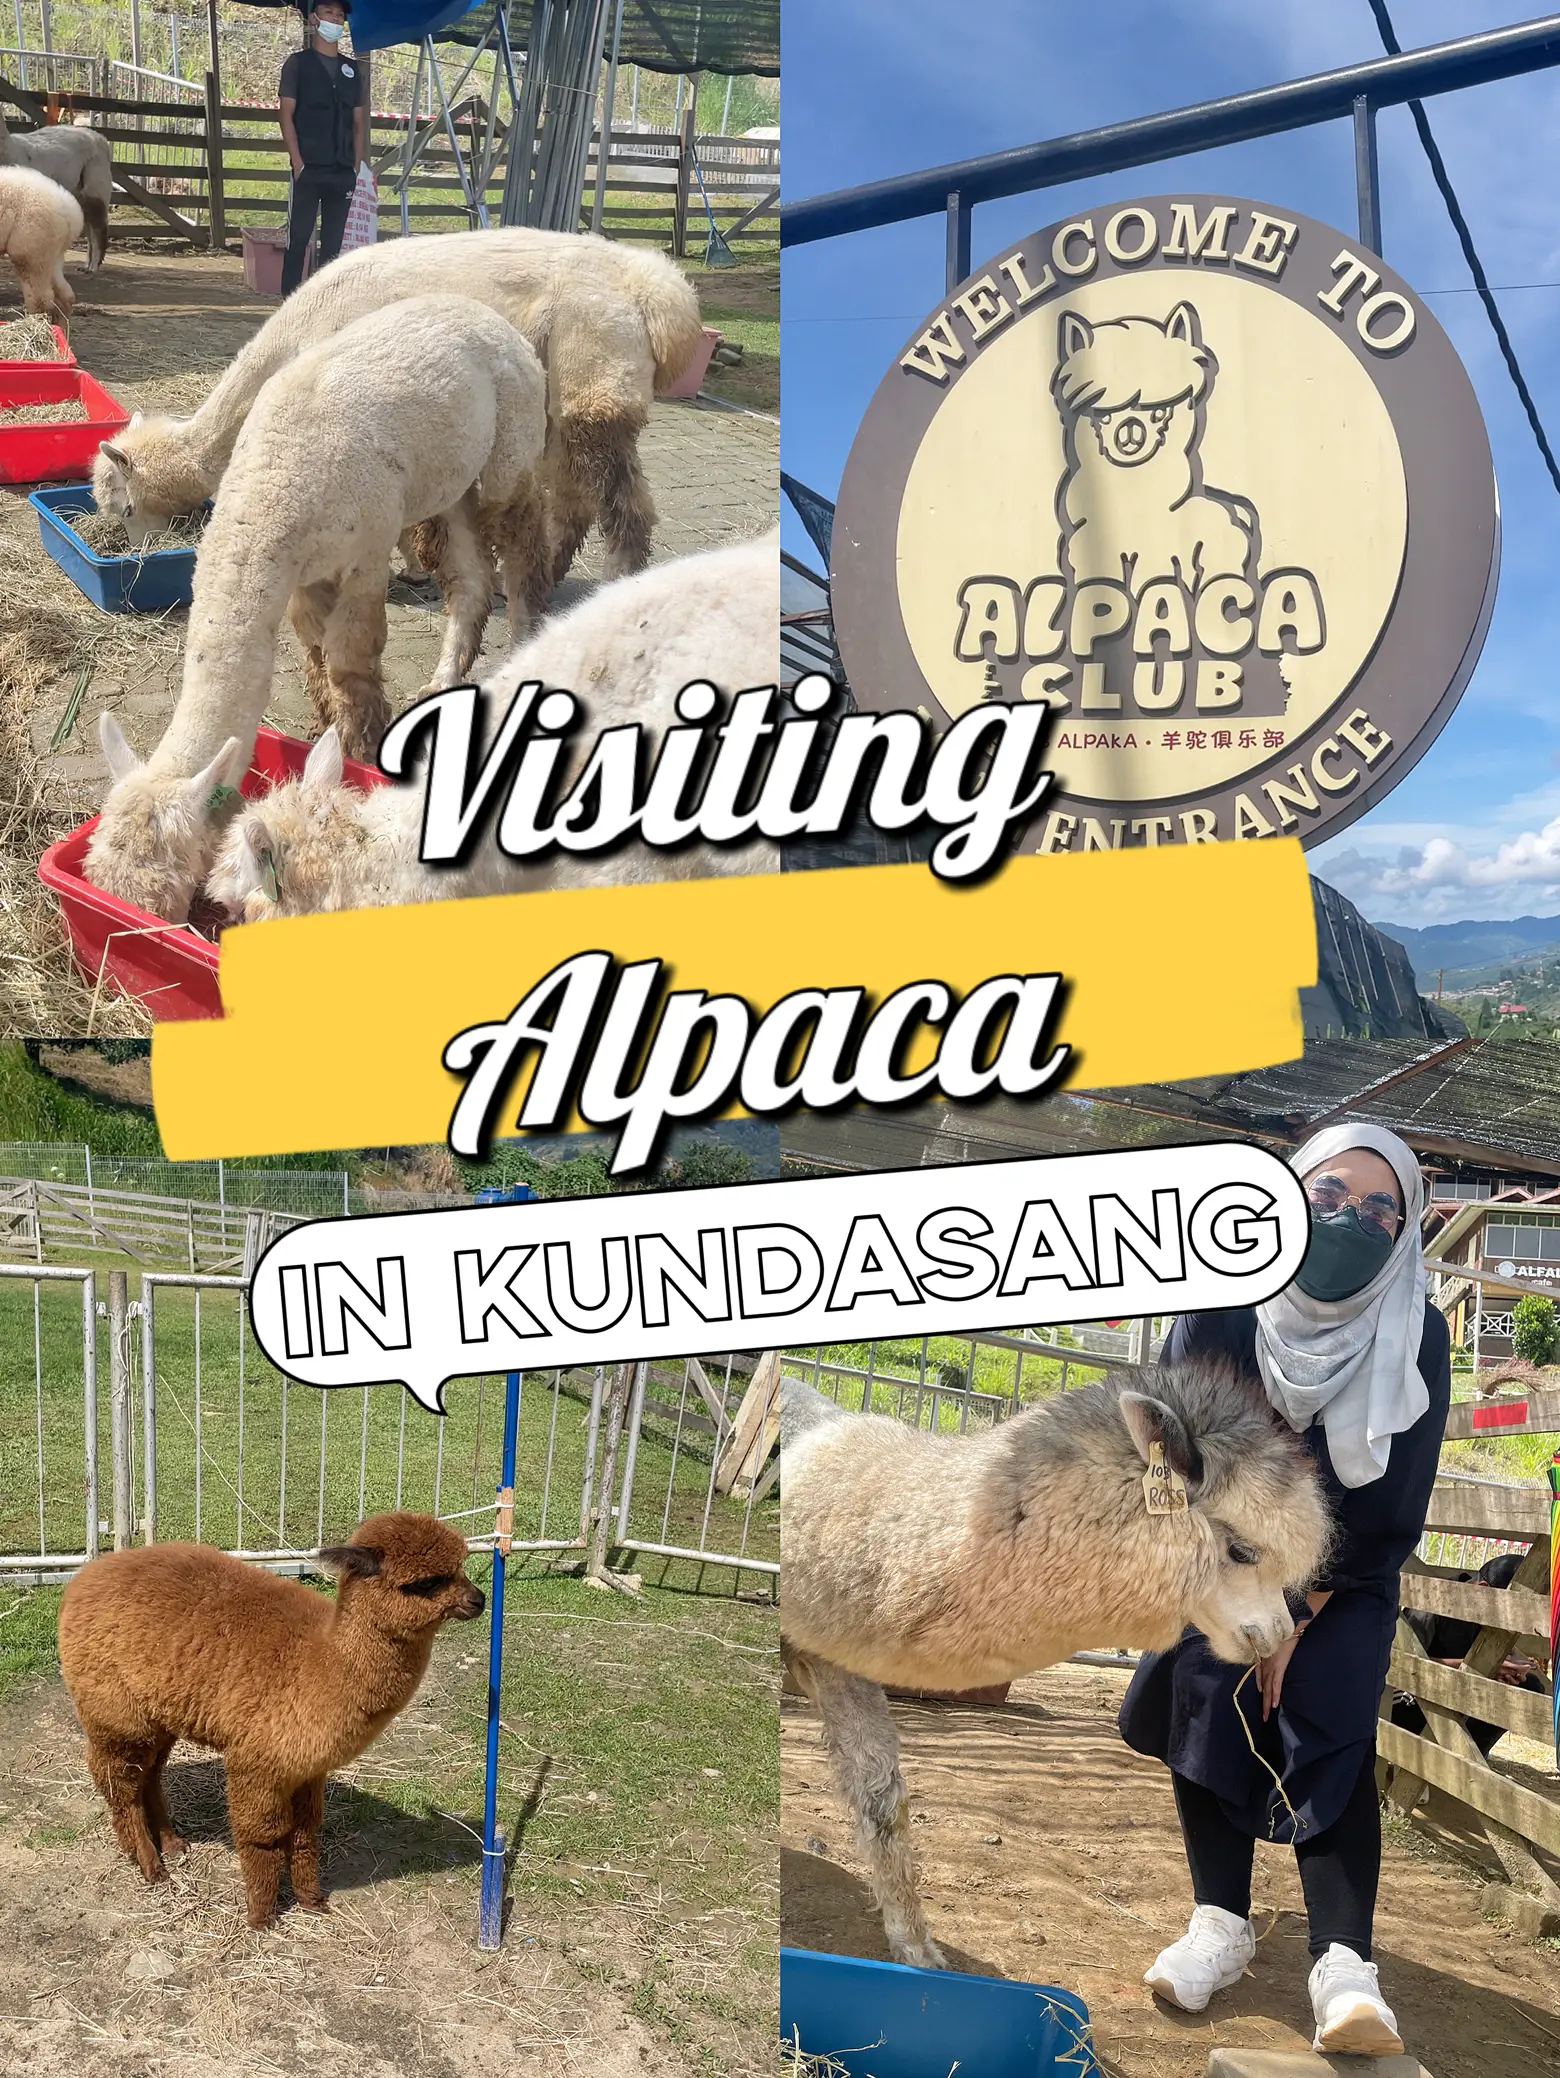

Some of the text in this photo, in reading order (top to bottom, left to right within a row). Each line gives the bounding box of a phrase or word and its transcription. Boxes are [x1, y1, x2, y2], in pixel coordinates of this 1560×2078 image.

[901, 203, 1417, 386] WELCOME TO
[955, 569, 1327, 660] ALPACA
[1020, 660, 1246, 713] CLUB
[1035, 708, 1395, 858] ENTRANCE
[1161, 730, 1286, 751] 羊驼俱乐部
